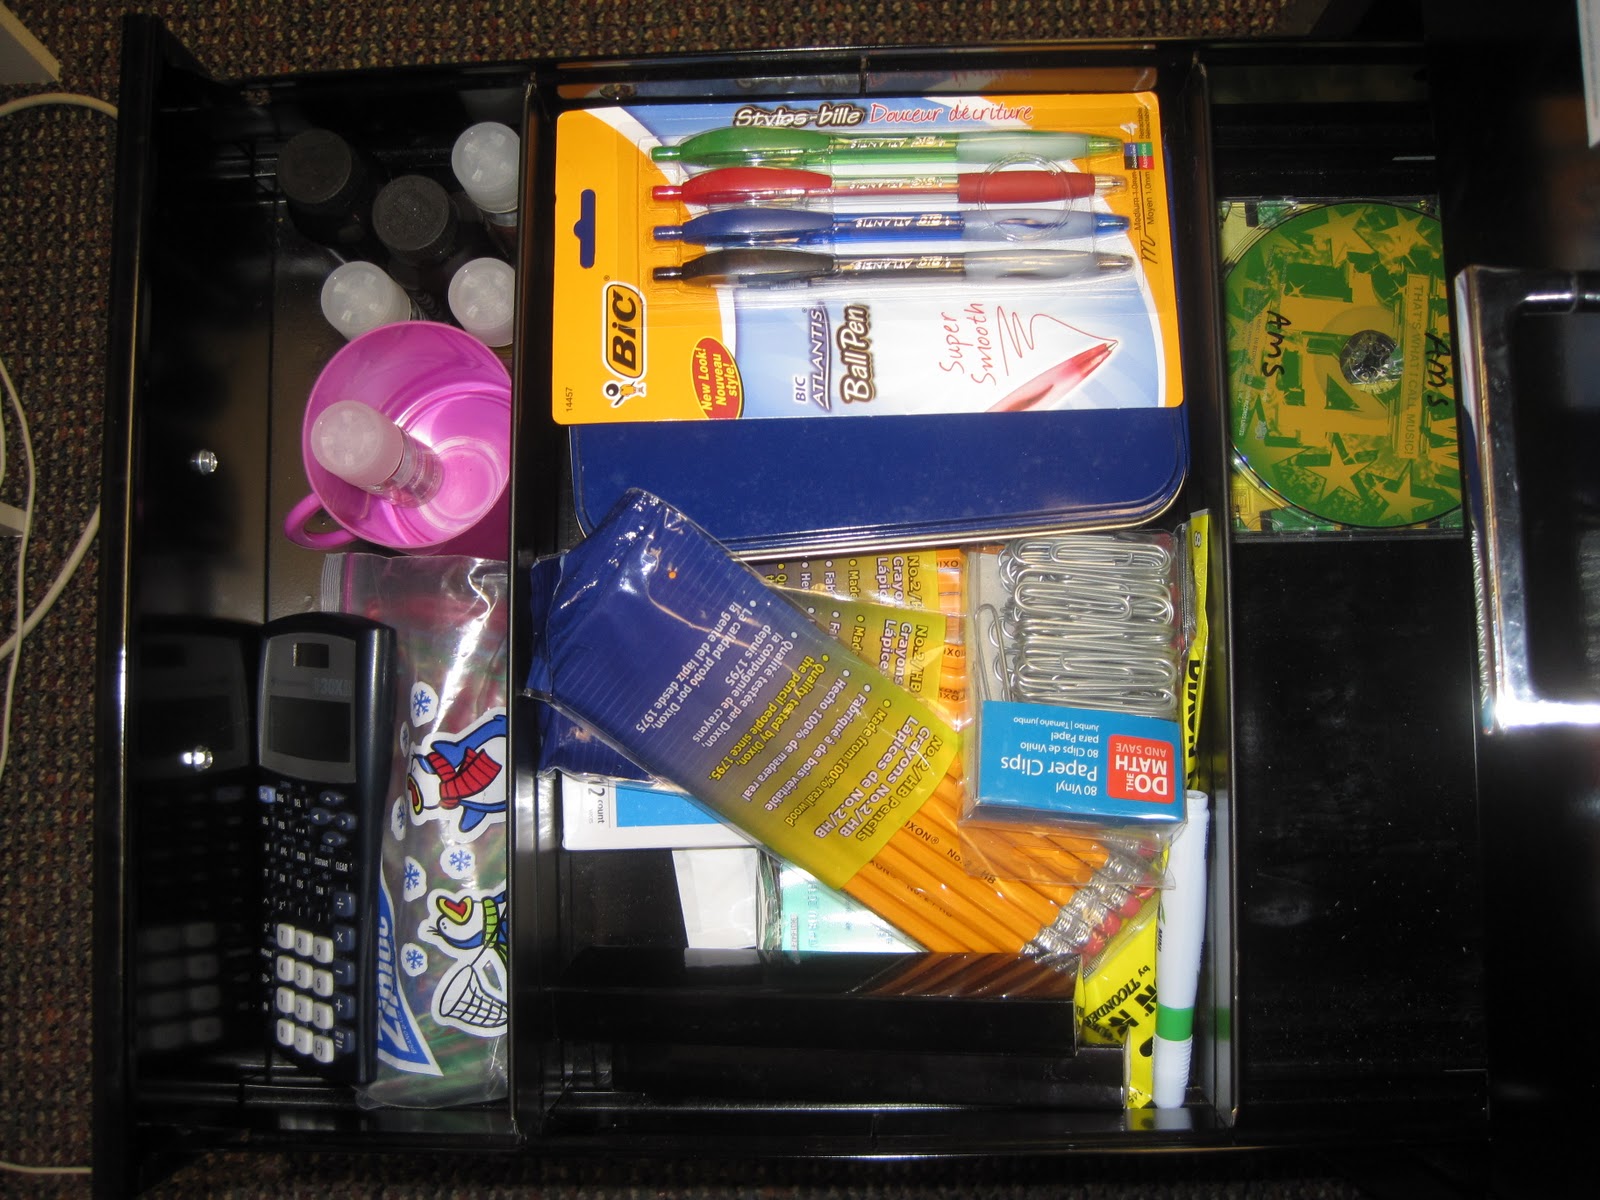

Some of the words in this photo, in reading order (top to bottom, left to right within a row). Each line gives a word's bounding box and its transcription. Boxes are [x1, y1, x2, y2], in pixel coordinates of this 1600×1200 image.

[870, 103, 942, 124] Douceur
[1131, 197, 1141, 231] Medium
[1145, 197, 1155, 225] Moyen
[1412, 284, 1424, 330] THAT'S
[939, 311, 973, 374] Super
[964, 303, 996, 386] Smooth
[1409, 332, 1421, 371] WHAT
[695, 347, 710, 379] Look!
[811, 309, 824, 407] ATLANTIS
[713, 353, 727, 406] Nouveau
[723, 363, 738, 397] style!
[795, 376, 806, 402] BIC
[566, 387, 574, 412] 14457
[702, 383, 713, 411] New
[1407, 378, 1418, 409] CALL
[1404, 413, 1416, 456] MUSIC!
[937, 560, 959, 568] IXO
[892, 556, 904, 605] Crayo
[729, 602, 742, 613] la
[738, 607, 753, 622] La
[707, 611, 731, 643] gente
[772, 632, 784, 643] la
[694, 642, 710, 661] del
[712, 621, 741, 660] calidad
[744, 624, 772, 659] depuis
[676, 659, 700, 682] lápiz
[731, 643, 774, 698] compagnie
[763, 640, 793, 678] Qualité
[798, 655, 815, 674] the
[909, 624, 928, 693] No.2/HB
[690, 656, 715, 688] probó
[725, 657, 748, 687] 1795
[795, 662, 825, 699] Quality
[654, 680, 679, 710] desde
[679, 684, 693, 703] por
[740, 675, 768, 708] testée
[775, 671, 800, 706] pencil
[819, 678, 847, 710] Hecho
[651, 702, 681, 730] Dixon,
[721, 696, 734, 710] de
[727, 706, 742, 723] par
[770, 698, 799, 732] tested
[830, 693, 866, 739] Fabriqué
[635, 709, 658, 734] 1975
[692, 708, 723, 743] crayons
[751, 704, 778, 735] people
[795, 709, 823, 741] 100%
[863, 708, 887, 737] Made
[1013, 716, 1039, 726] jumbo
[1074, 722, 1099, 732] Jumbo
[701, 721, 731, 748] Dixon,
[730, 733, 752, 757] since
[762, 729, 775, 743] by
[784, 739, 799, 754] de
[877, 715, 919, 770] Lápices
[1020, 742, 1048, 752] Vinilo
[1051, 732, 1077, 743] Papel
[1078, 735, 1099, 744] para
[736, 741, 765, 766] Dixon,
[813, 744, 827, 758] de
[844, 736, 868, 760] from
[886, 726, 930, 784] Crayons
[1049, 745, 1061, 754] de
[1063, 747, 1086, 757] Clips
[1087, 749, 1099, 758] 80
[1116, 742, 1142, 755] SAVE
[1144, 744, 1167, 757] AND
[708, 756, 734, 781] 1795.
[756, 752, 788, 782] madera
[797, 757, 818, 777] bois
[821, 758, 848, 788] 100%
[896, 735, 943, 798] No.2/HB
[1001, 756, 1044, 776] Clips
[1048, 761, 1098, 782] Paper
[1115, 754, 1167, 776] MATH
[741, 780, 759, 801] real
[861, 770, 878, 788] de
[1056, 782, 1083, 795] Vinyl
[1084, 785, 1098, 796] 80
[1125, 772, 1134, 791] THE
[1134, 775, 1168, 796] DO
[765, 775, 799, 811] véritable
[806, 786, 823, 807] real
[597, 800, 605, 824] count
[785, 801, 809, 827] wood
[814, 787, 865, 838] No.2/HB
[838, 783, 890, 838] No.2/HB
[856, 796, 900, 842] Pencils
[905, 820, 940, 845] IXON®
[947, 848, 962, 864] No.
[1138, 965, 1151, 977] by
